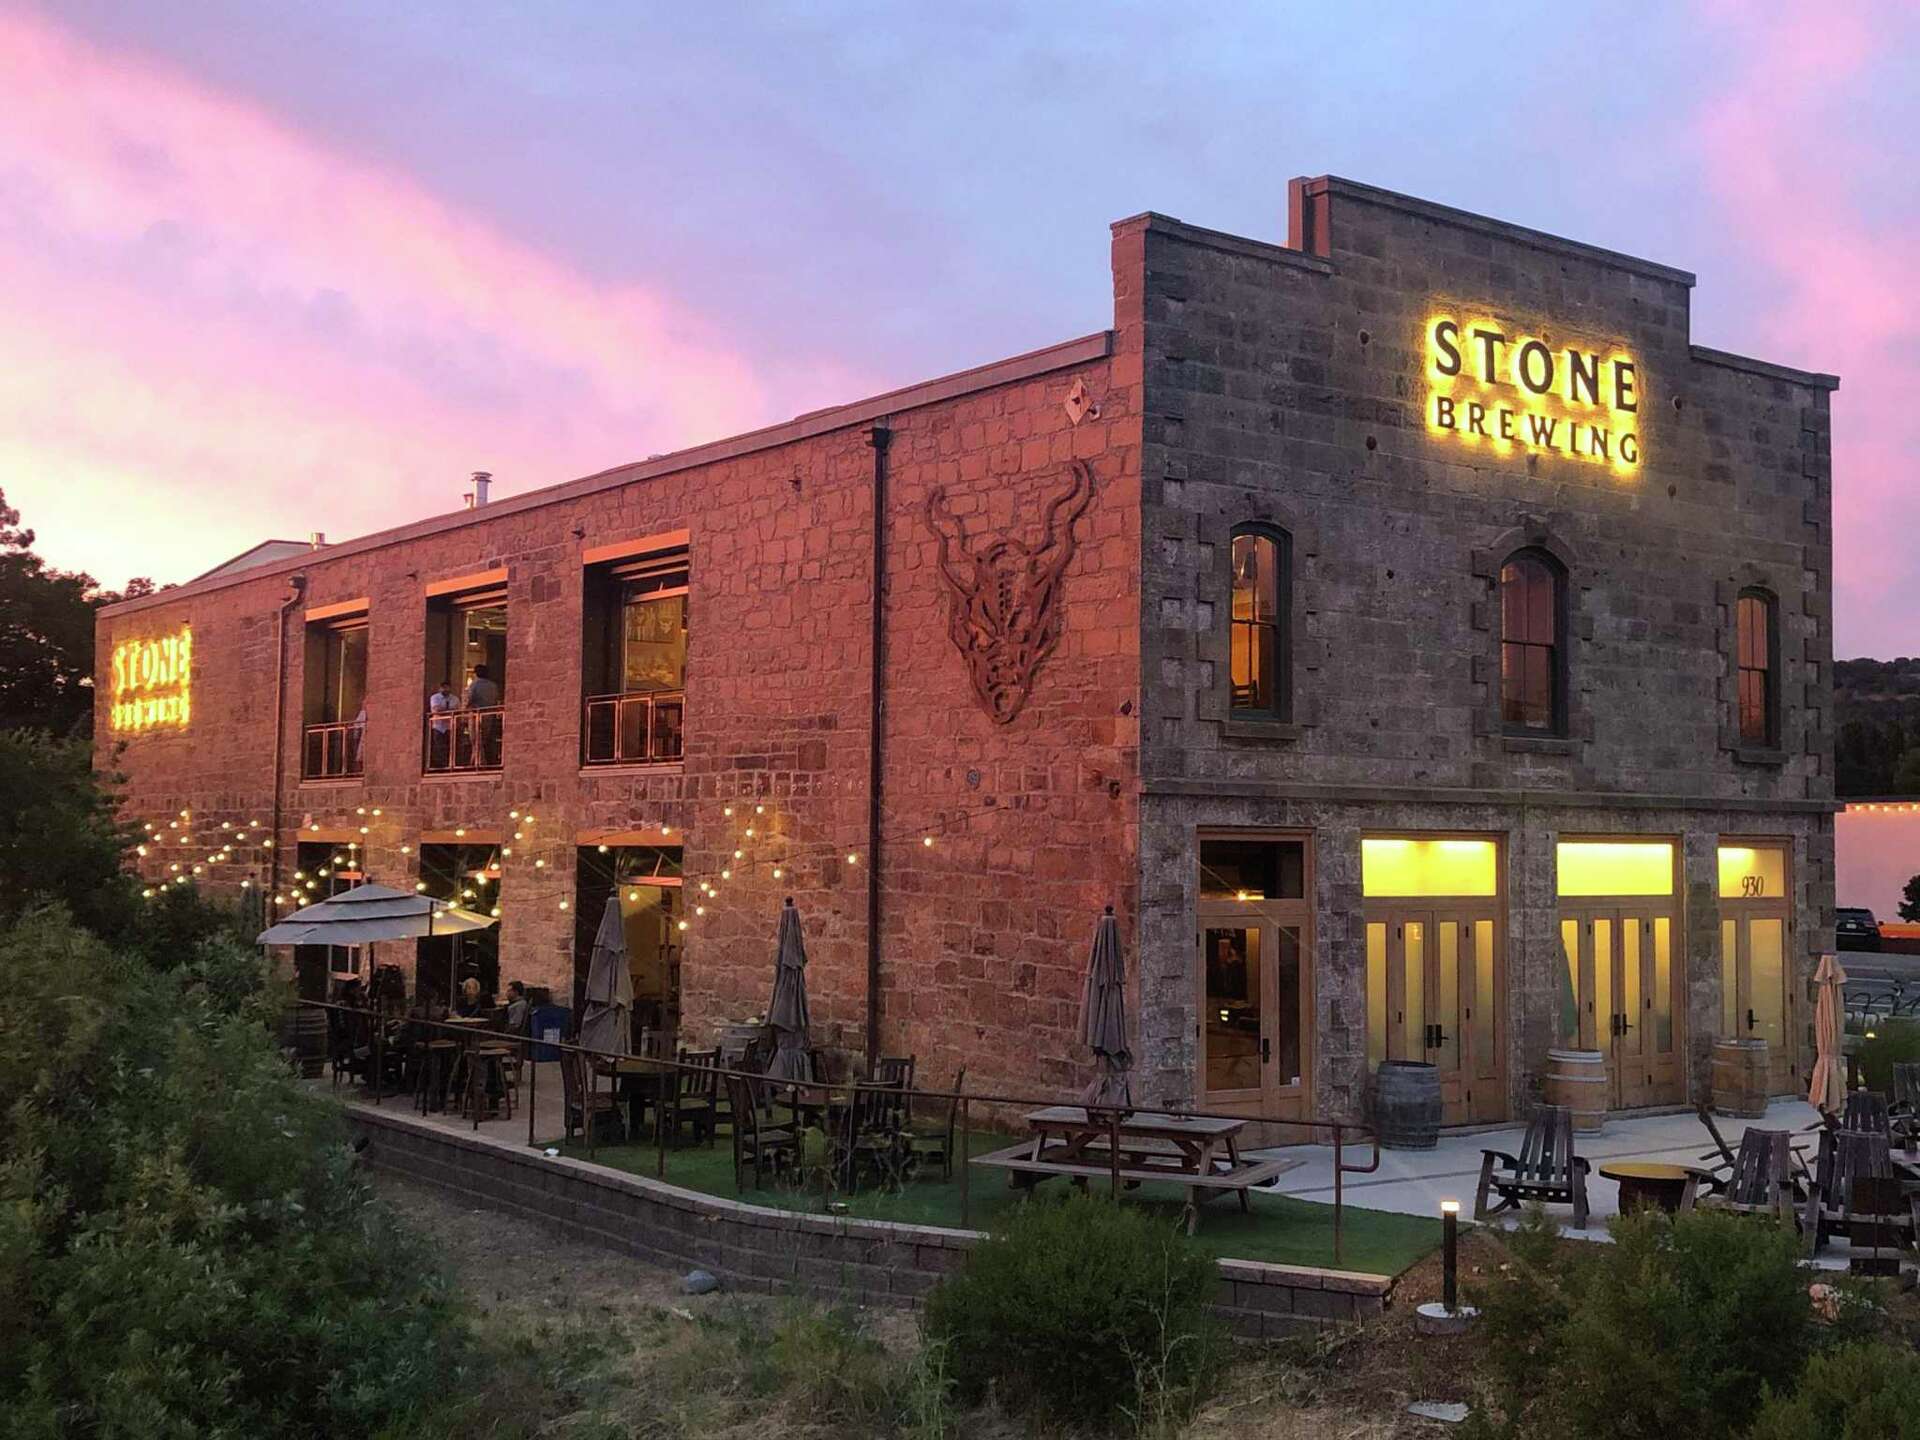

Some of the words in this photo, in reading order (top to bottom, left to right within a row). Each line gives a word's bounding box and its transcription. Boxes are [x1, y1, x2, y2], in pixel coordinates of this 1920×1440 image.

[1435, 320, 1637, 413] STONE
[1436, 396, 1637, 463] BREWING
[1742, 875, 1764, 897] 930
